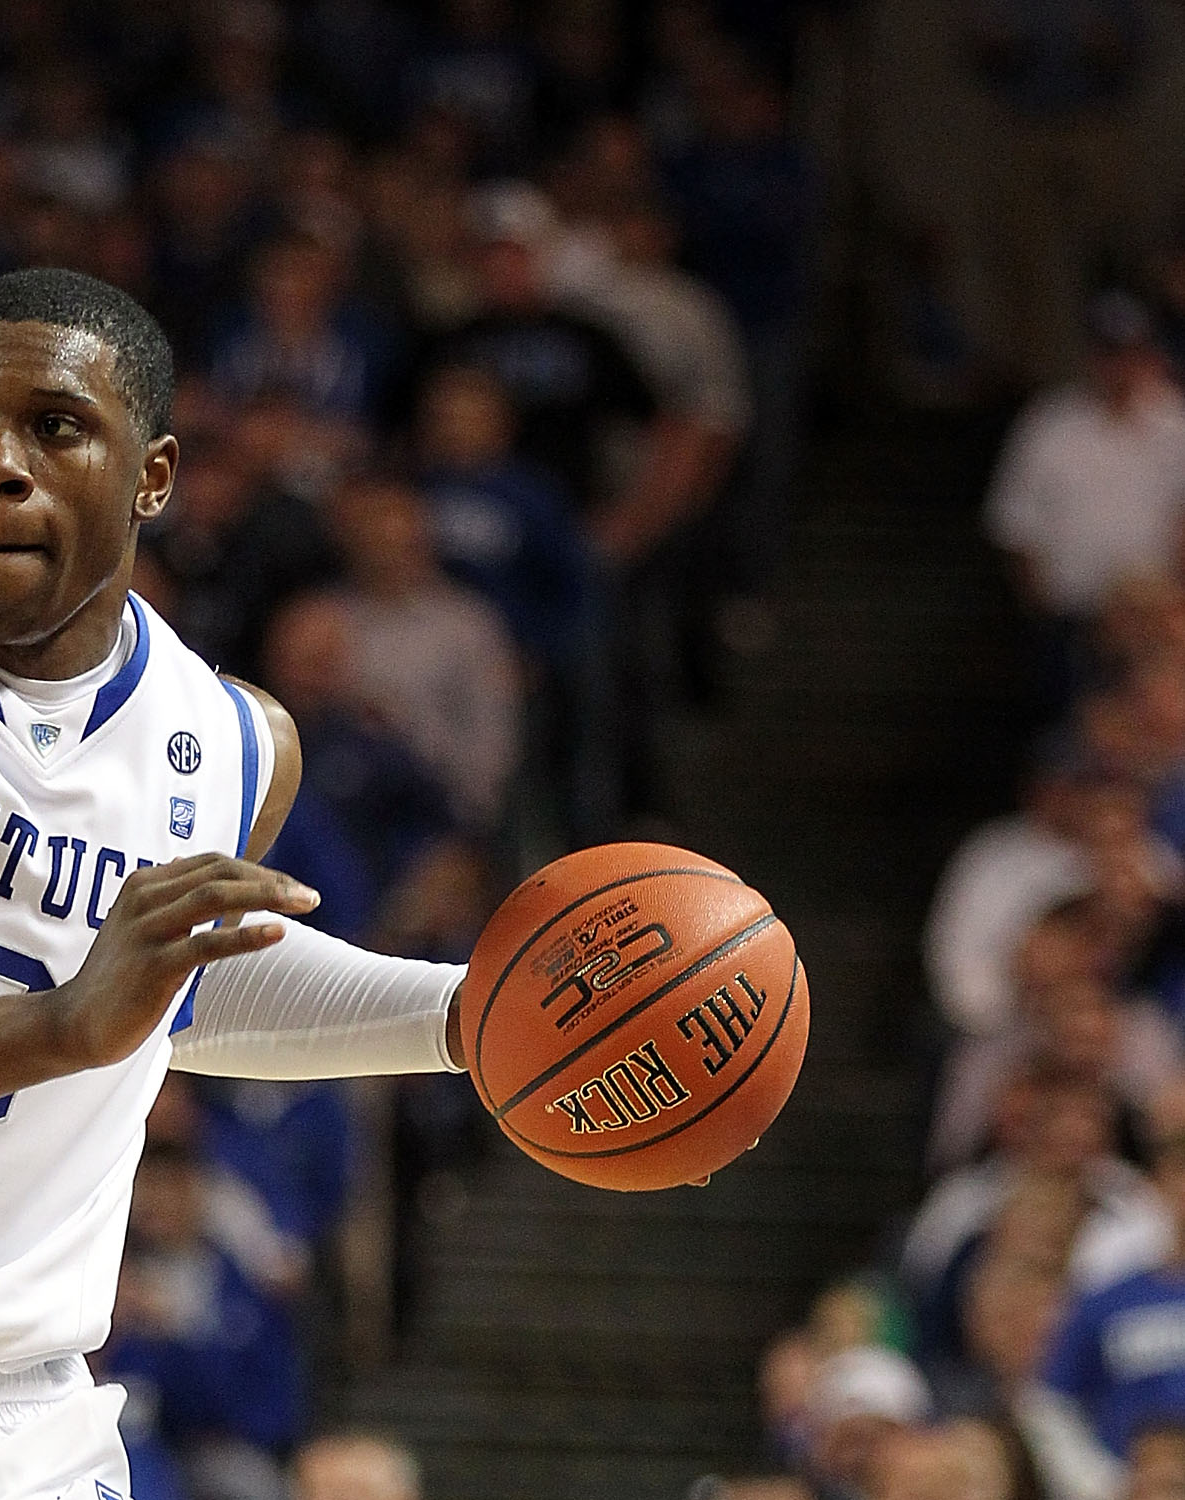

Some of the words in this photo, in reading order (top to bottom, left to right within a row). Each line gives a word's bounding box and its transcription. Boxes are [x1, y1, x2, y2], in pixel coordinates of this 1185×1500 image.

[170, 732, 201, 772] SEC
[676, 970, 768, 1078] THE
[553, 1039, 692, 1135] ROCK
